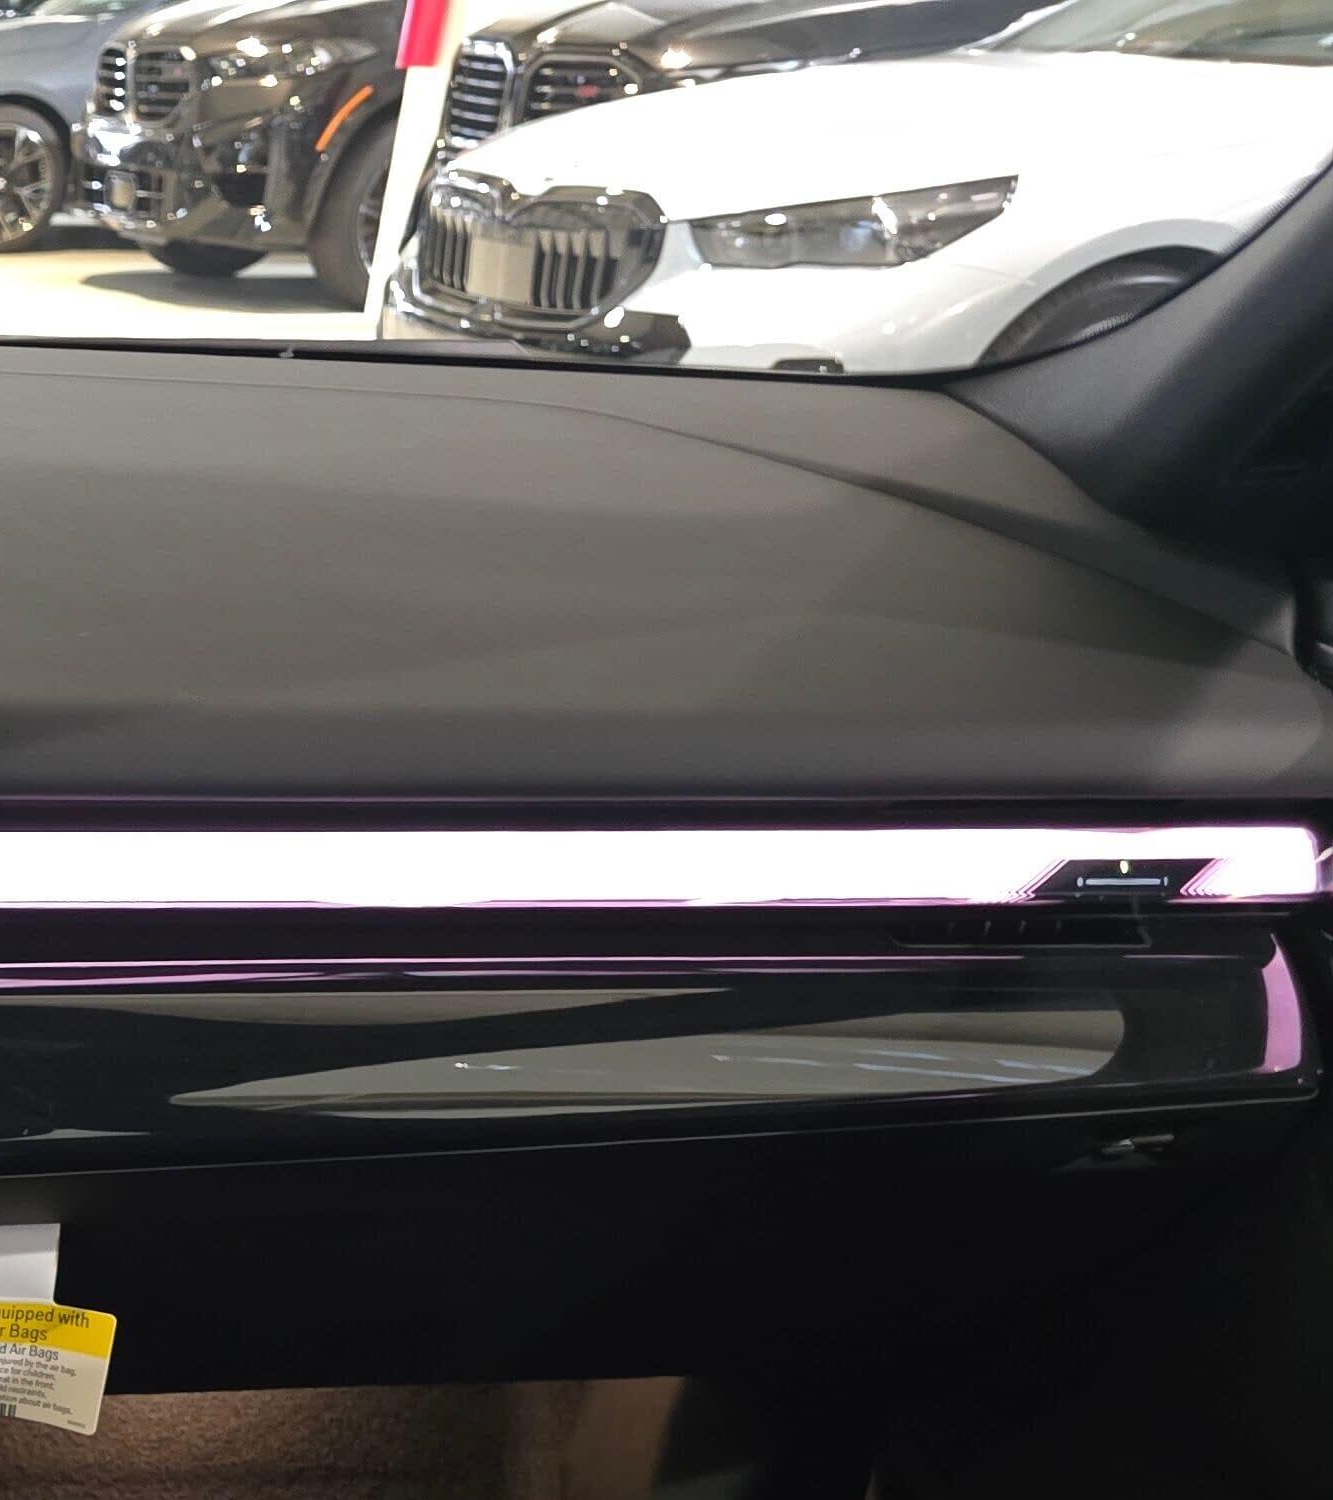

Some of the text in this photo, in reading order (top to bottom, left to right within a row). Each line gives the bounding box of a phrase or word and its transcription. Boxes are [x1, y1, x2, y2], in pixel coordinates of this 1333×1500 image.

[58, 1310, 90, 1328] with
[9, 1323, 48, 1343] Bags
[9, 1342, 26, 1356] Air
[29, 1345, 60, 1362] Bags
